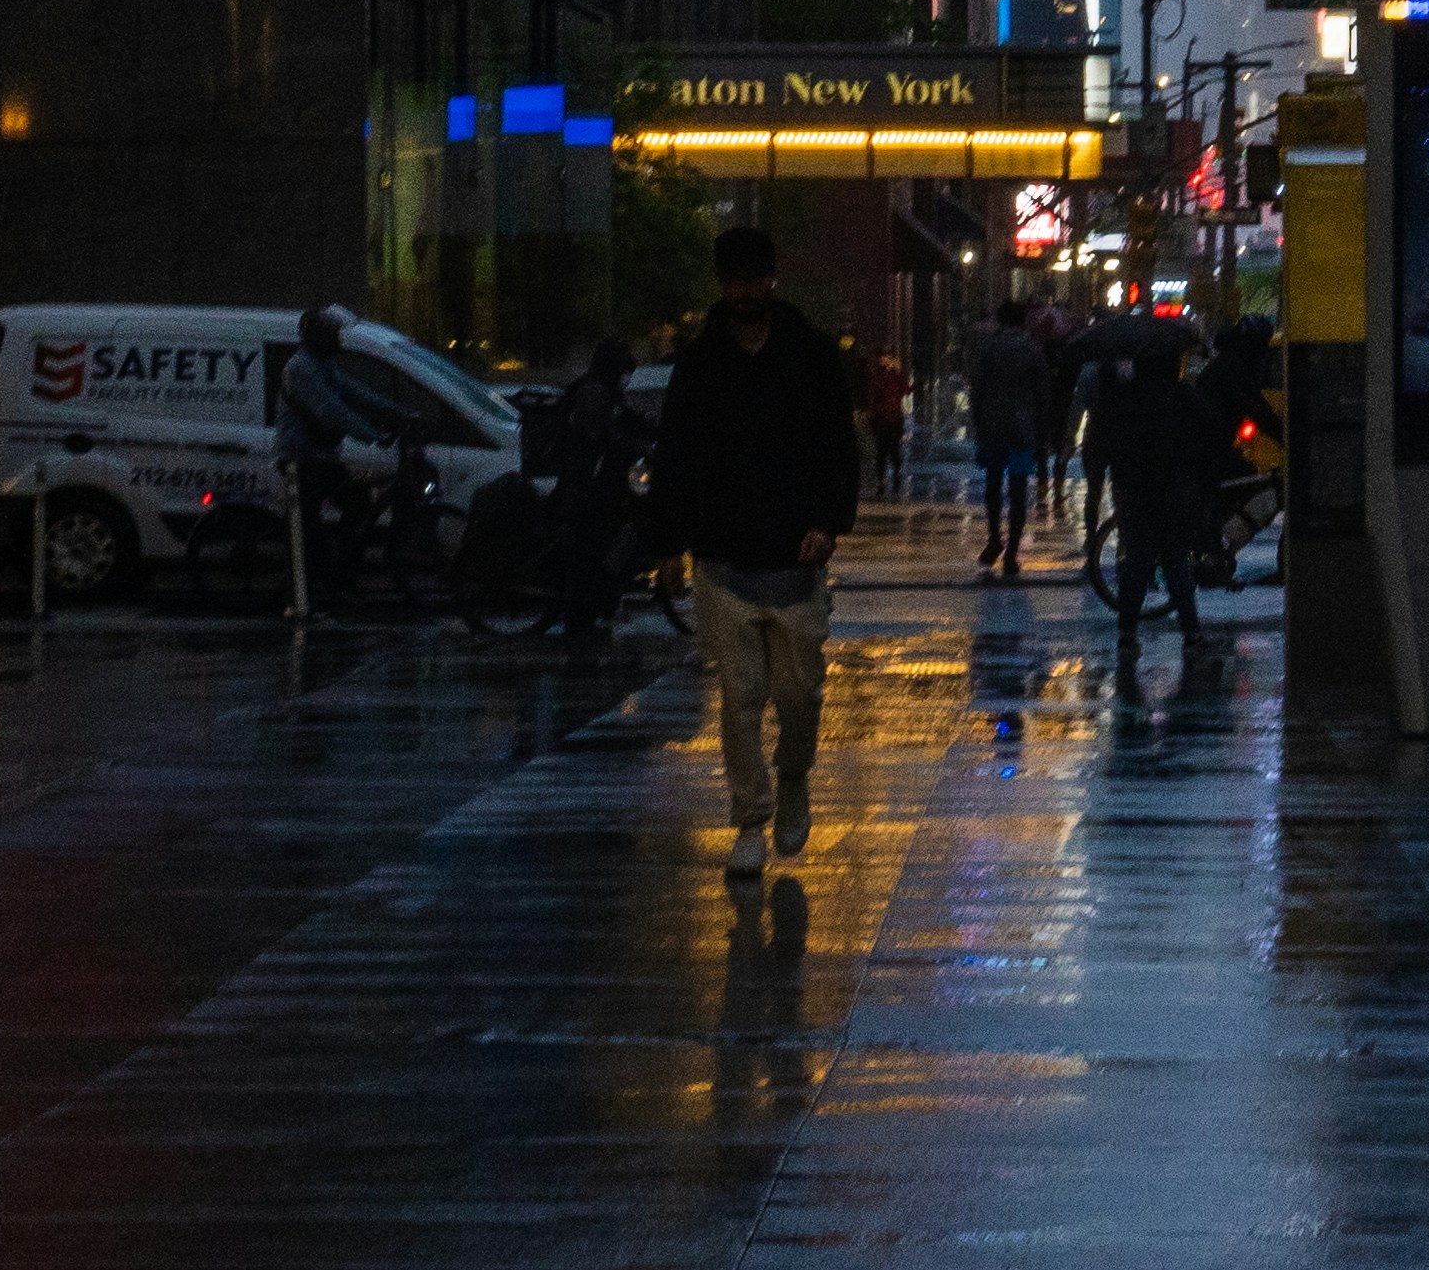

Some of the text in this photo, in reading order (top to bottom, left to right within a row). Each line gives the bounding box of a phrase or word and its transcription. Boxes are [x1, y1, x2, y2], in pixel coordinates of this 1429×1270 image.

[638, 70, 974, 107] aton New York
[92, 346, 258, 382] SAFETY
